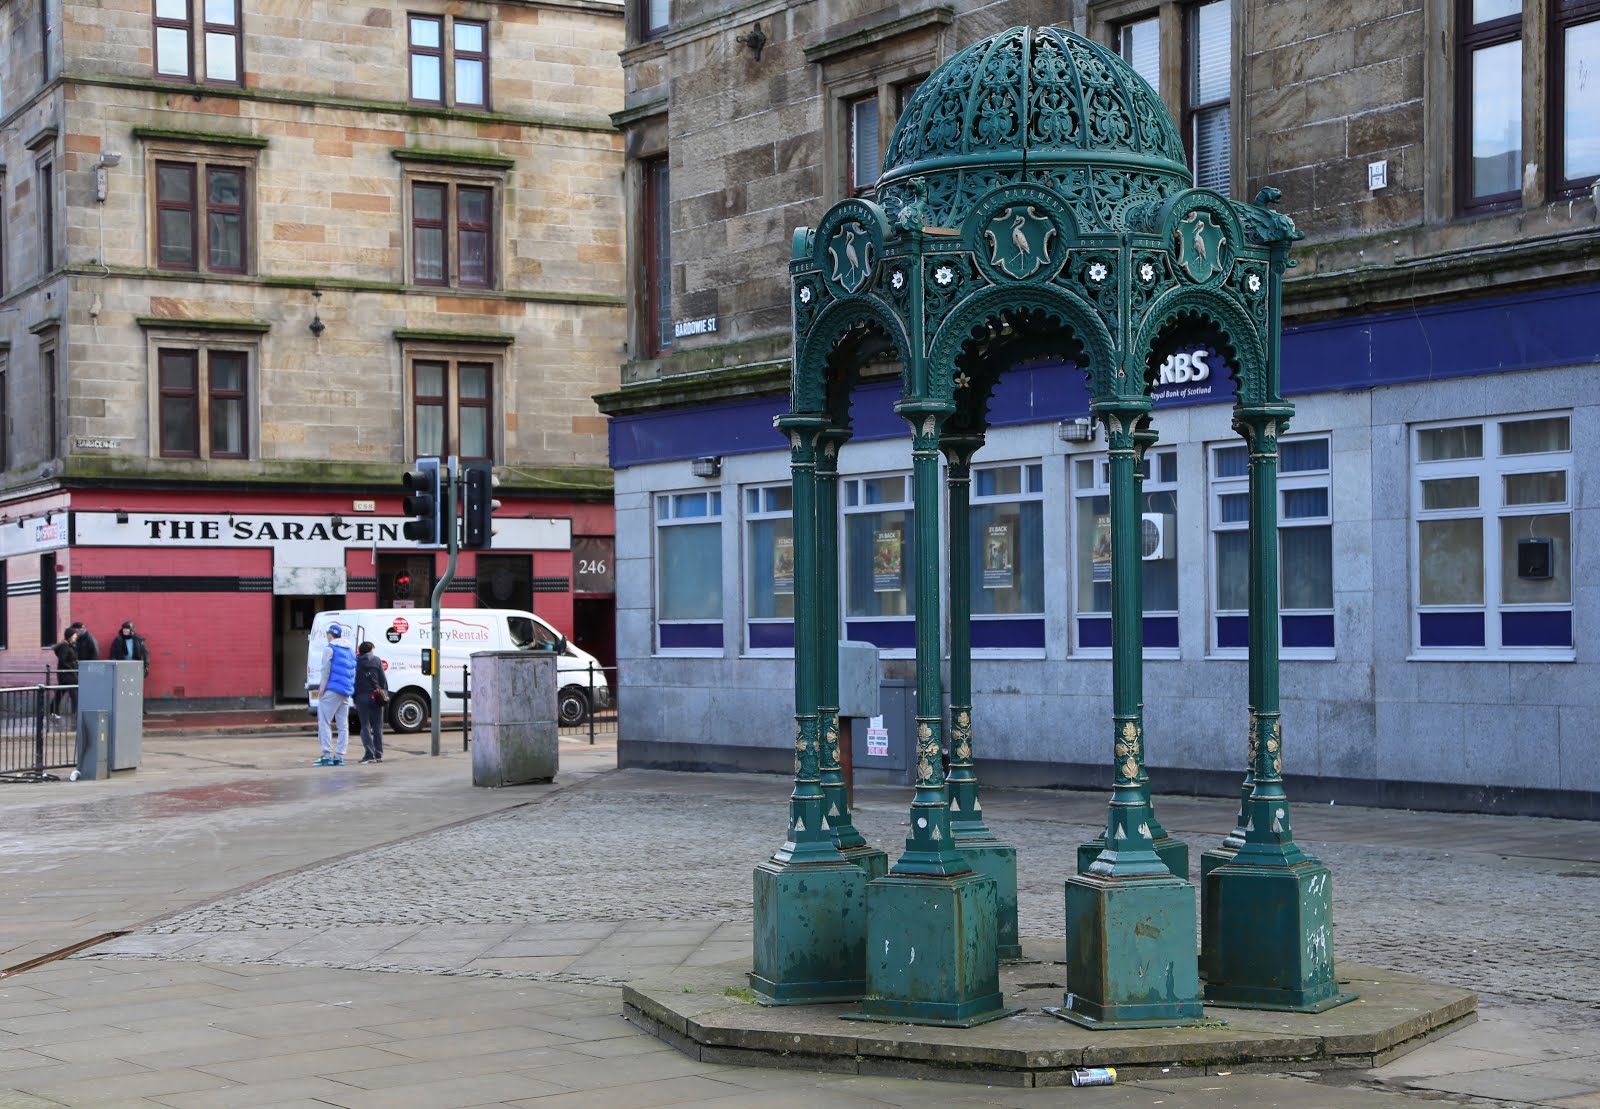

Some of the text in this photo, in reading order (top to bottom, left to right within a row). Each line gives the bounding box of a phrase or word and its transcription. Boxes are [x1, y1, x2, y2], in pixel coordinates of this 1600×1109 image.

[930, 243, 961, 251] KEEP
[975, 196, 997, 217] THE
[1004, 190, 1064, 214] PAVEMENT
[675, 317, 717, 337] BARDOWIE ST
[1160, 350, 1209, 385] RBS
[1150, 385, 1212, 401] Royal Bank of Scotland
[144, 520, 399, 541] THE SARACEN
[579, 559, 606, 574] 246
[419, 629, 489, 641] PrryRentals
